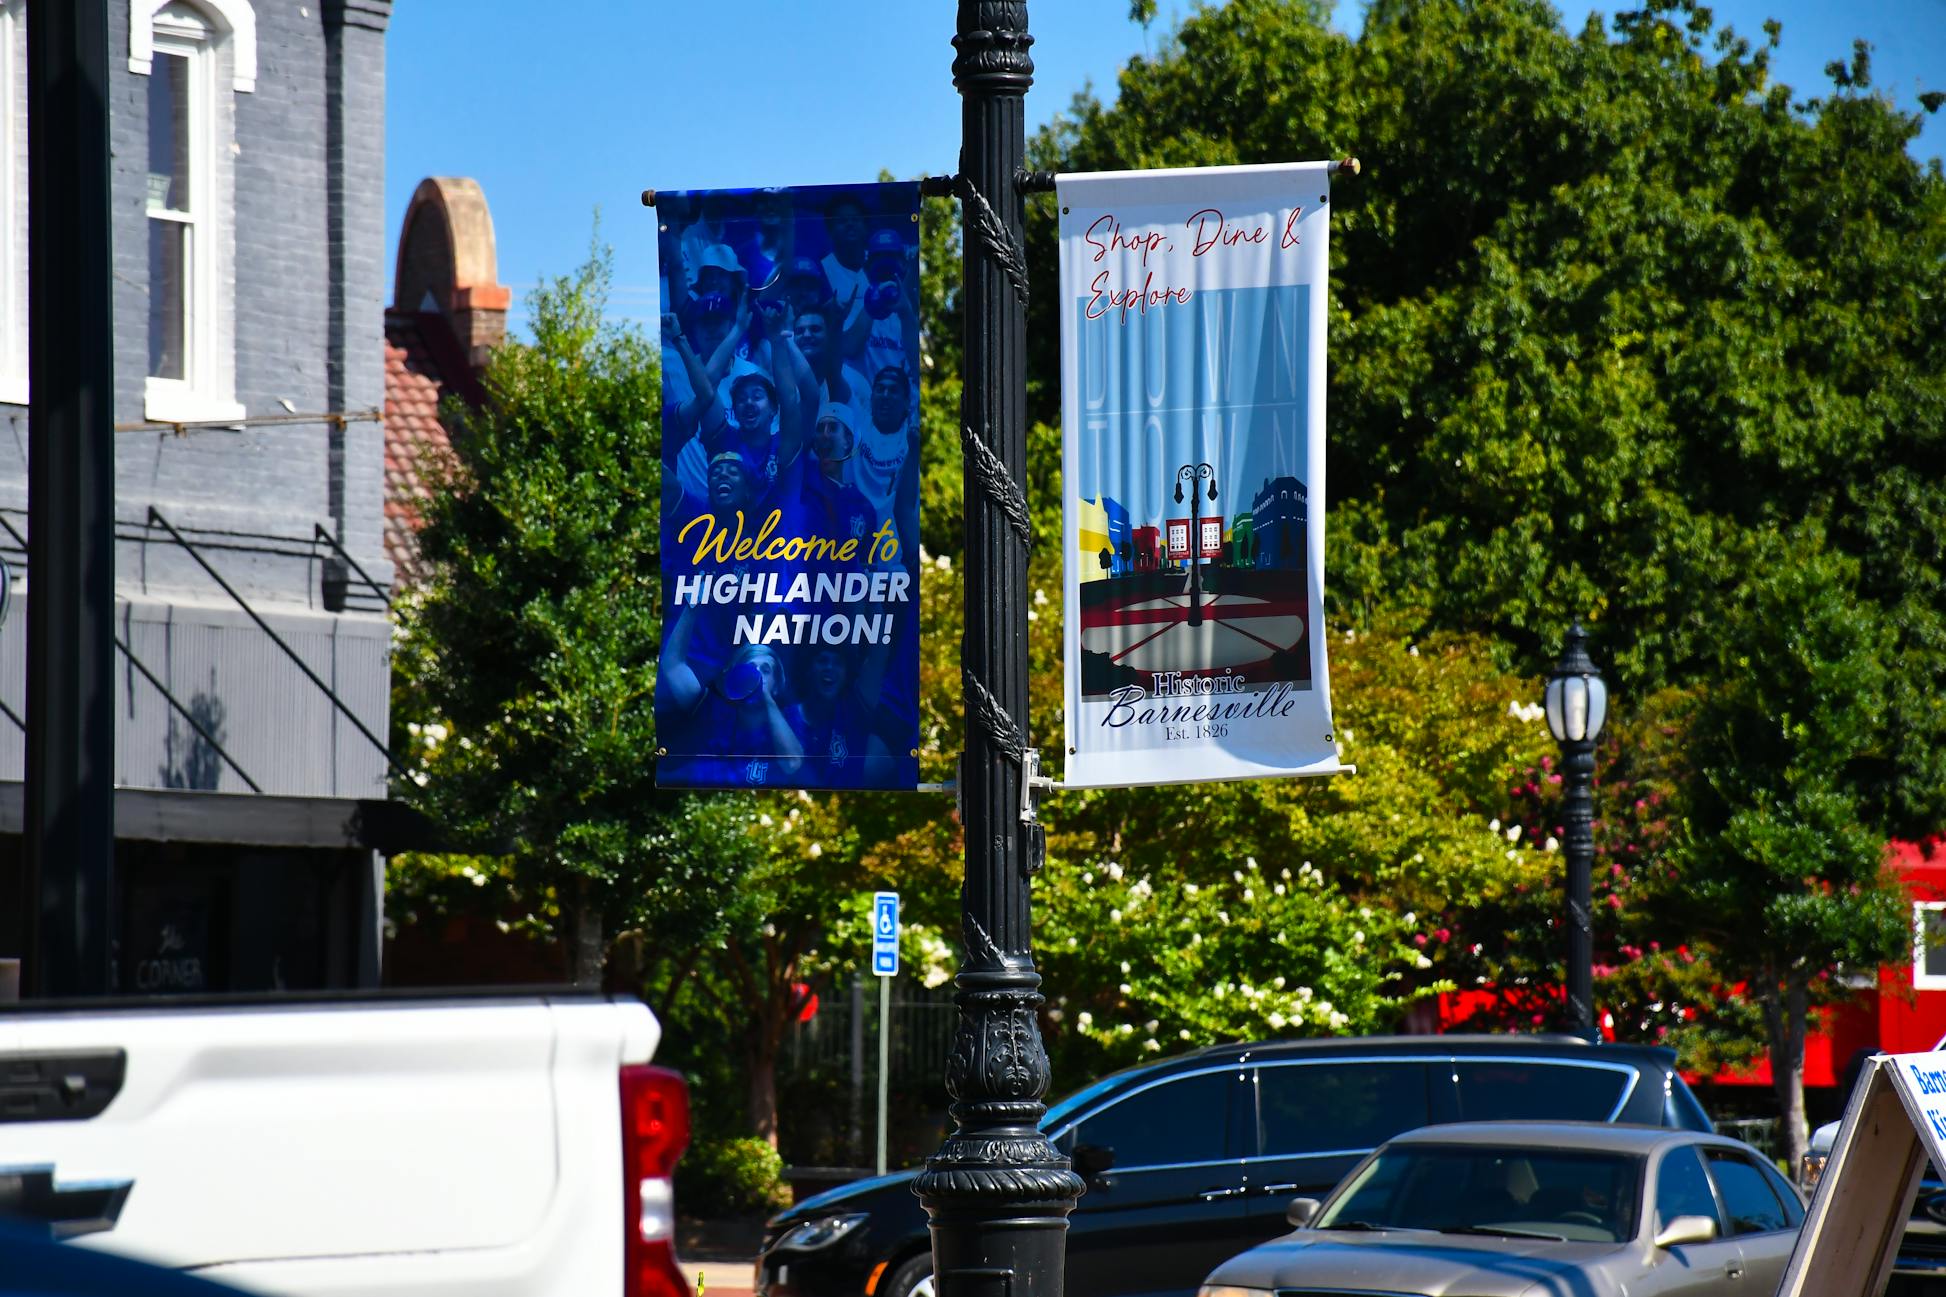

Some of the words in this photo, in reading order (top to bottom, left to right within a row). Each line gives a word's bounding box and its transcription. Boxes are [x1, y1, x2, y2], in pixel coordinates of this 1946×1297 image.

[1085, 214, 1174, 267] Shop,
[1186, 208, 1269, 257] Dine
[1281, 206, 1302, 250] &
[1085, 270, 1193, 325] Explore
[678, 508, 857, 566] Welcome
[867, 518, 899, 565] to
[673, 571, 911, 606] HIGHLANDER
[732, 613, 894, 646] NATION!
[1152, 667, 1246, 698] Historic
[1101, 681, 1296, 728] Barnesville
[1166, 726, 1190, 741] Est.
[1196, 723, 1229, 739] 1826
